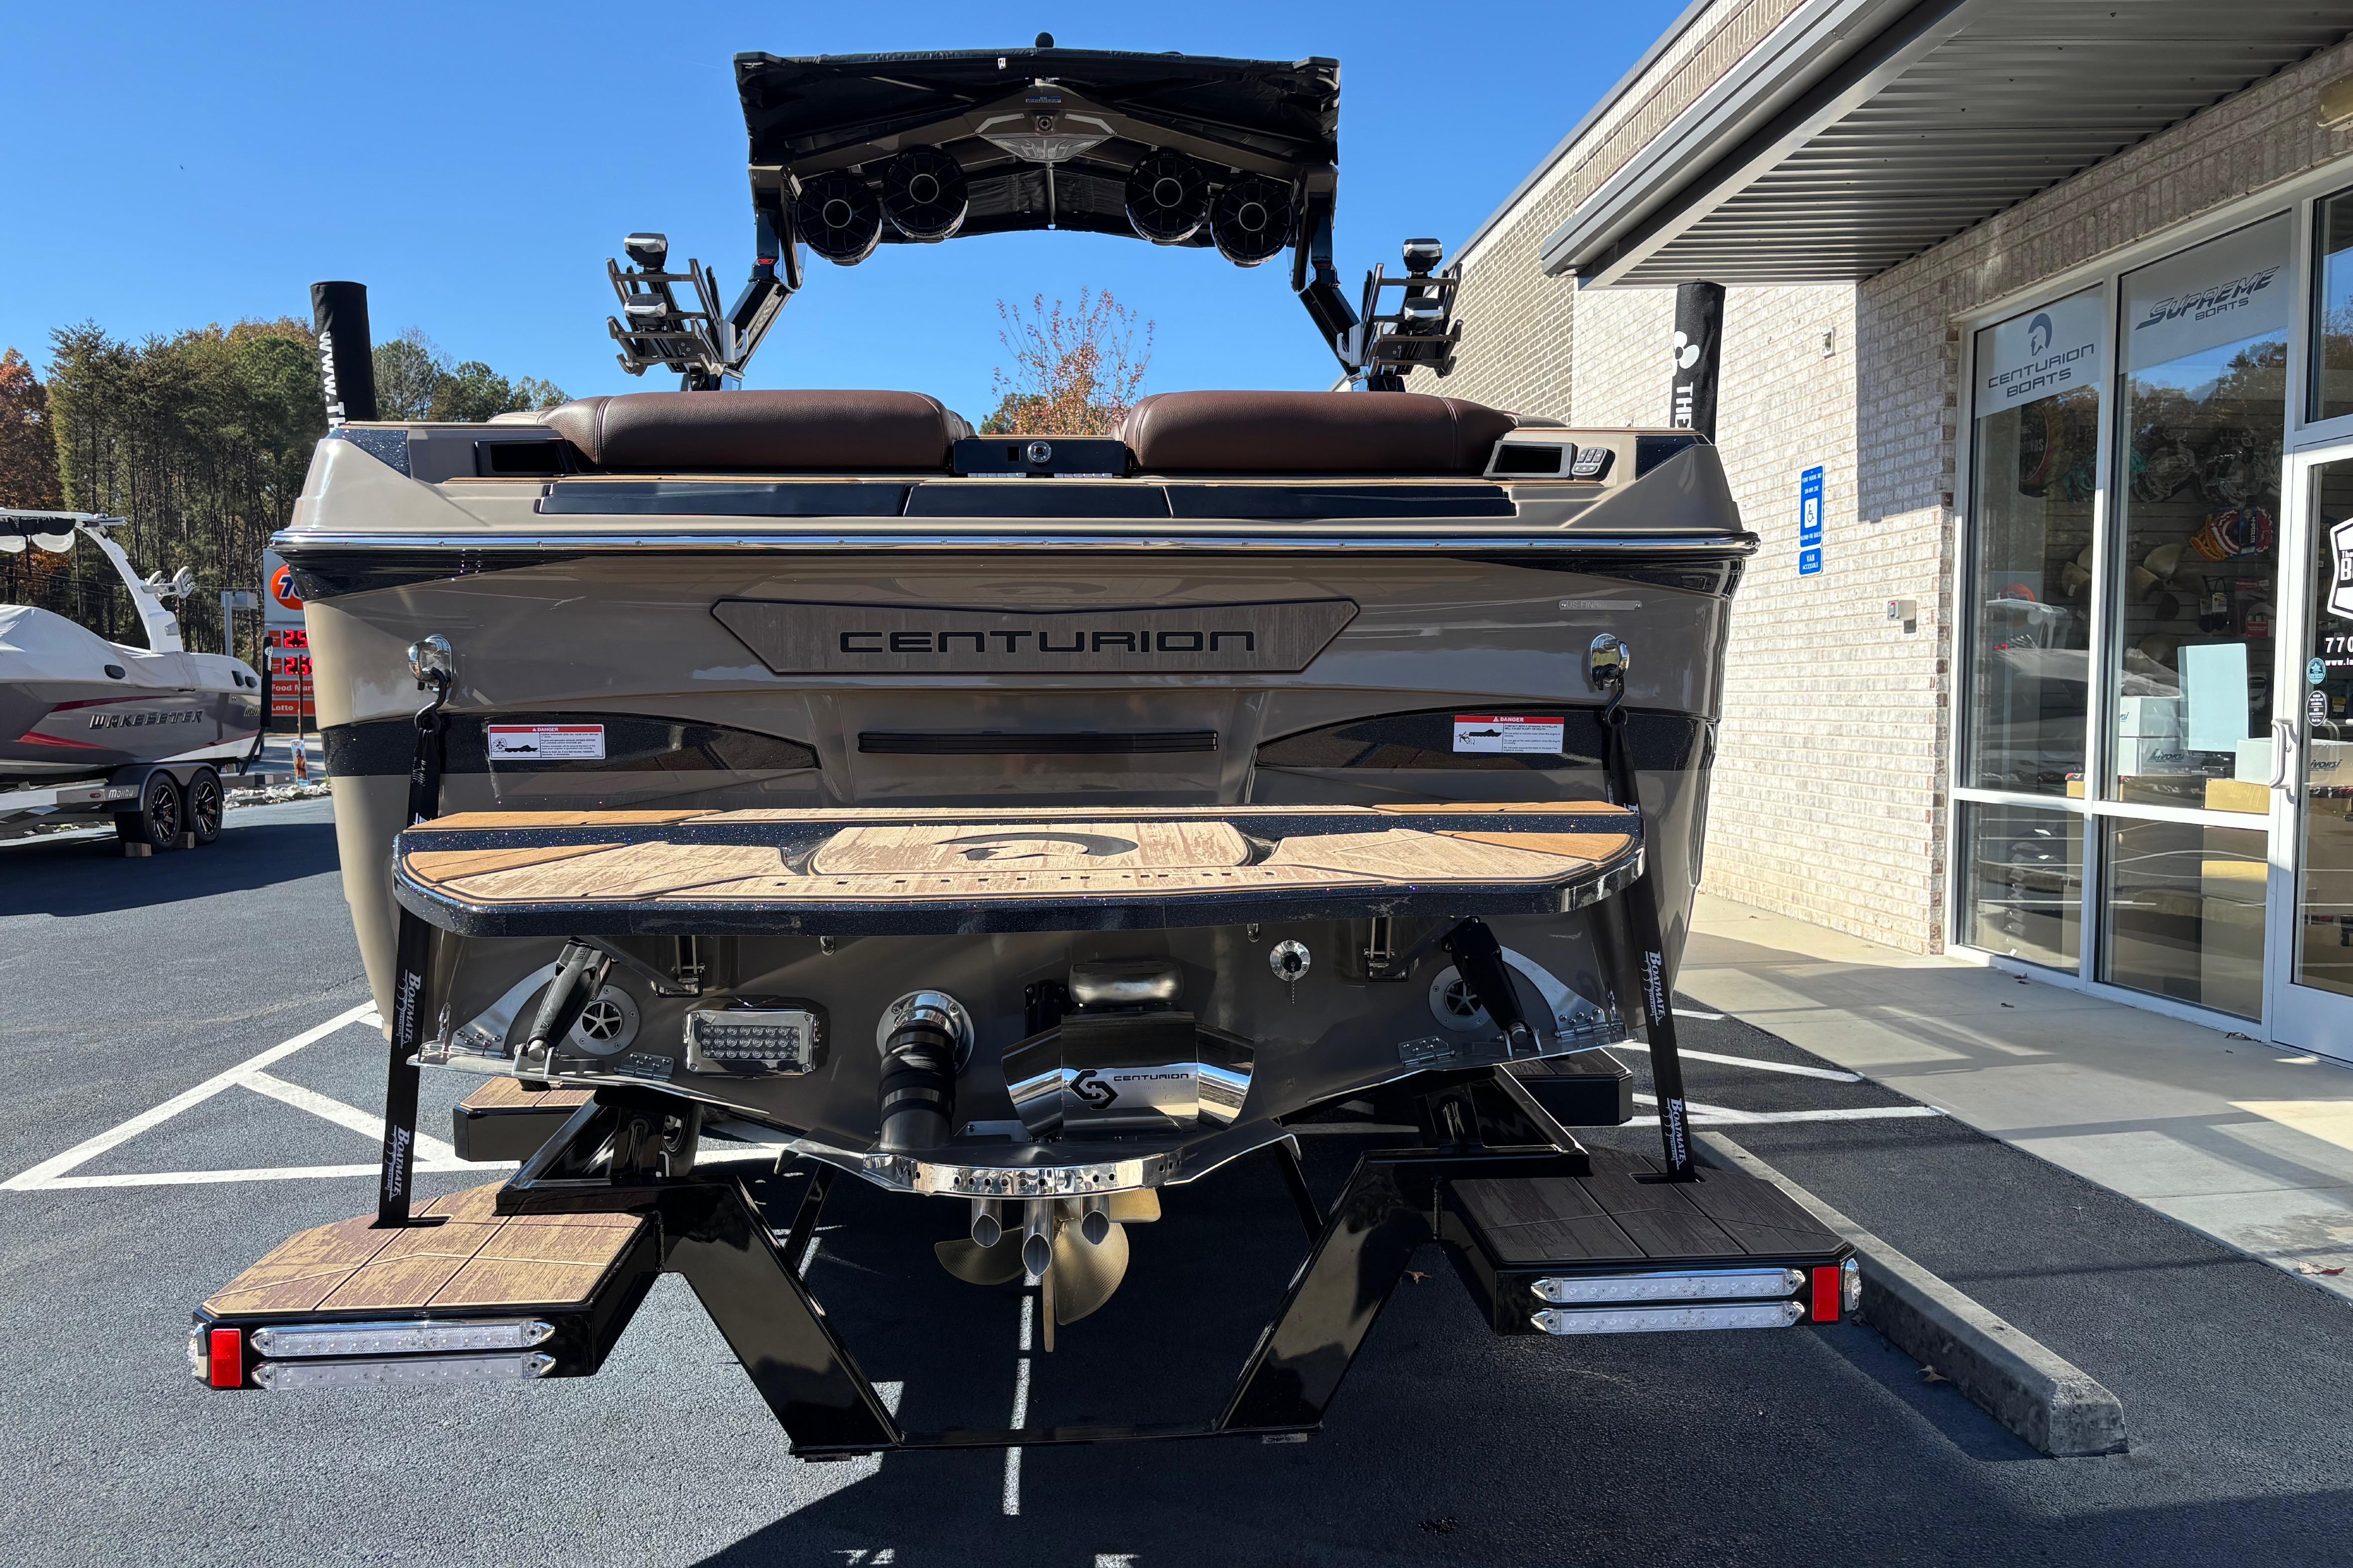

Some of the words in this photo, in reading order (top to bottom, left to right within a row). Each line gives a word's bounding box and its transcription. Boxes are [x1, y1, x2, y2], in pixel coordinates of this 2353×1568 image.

[2135, 266, 2280, 330] SUPREME
[2195, 297, 2249, 321] BOATS
[1988, 343, 2094, 389] CENTURION
[2007, 368, 2071, 397] BOATS
[1674, 382, 1694, 428] THE
[1806, 554, 1815, 563] VAN
[840, 630, 1255, 653] CENTURION
[89, 709, 203, 729] WAKESETTER
[108, 788, 134, 799] Malibu
[1649, 951, 1665, 1016] BOATMATE
[405, 972, 421, 1043] BOATMATE
[1114, 1073, 1189, 1081] CENTURION
[1670, 1098, 1686, 1161] BOATMATE
[394, 1127, 410, 1195] BOATMATE
